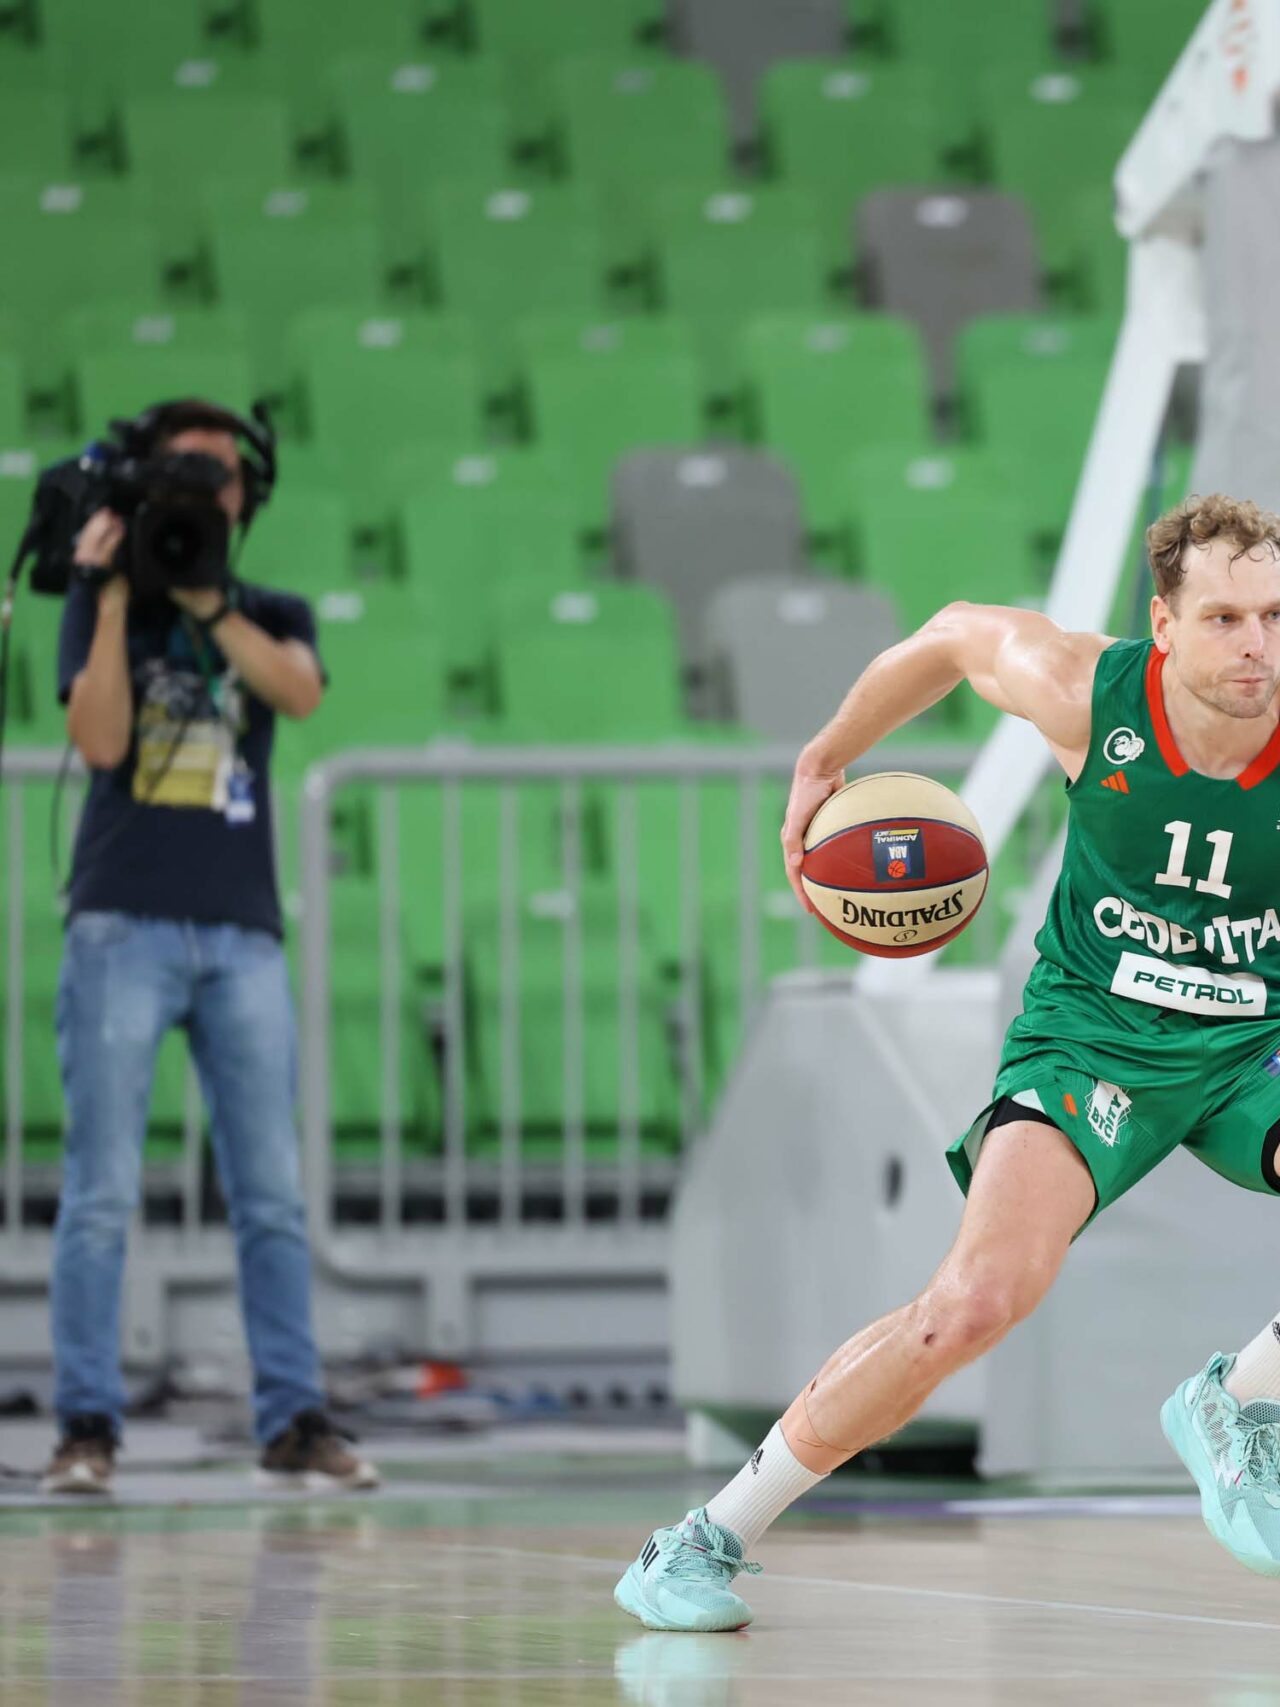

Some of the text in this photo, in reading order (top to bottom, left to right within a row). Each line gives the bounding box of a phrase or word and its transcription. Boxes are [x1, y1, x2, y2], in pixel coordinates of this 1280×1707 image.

[873, 834, 918, 844] ADMIRAL
[1154, 820, 1234, 899] 11
[842, 889, 964, 928] SPALDING
[1132, 970, 1255, 1005] PETROL
